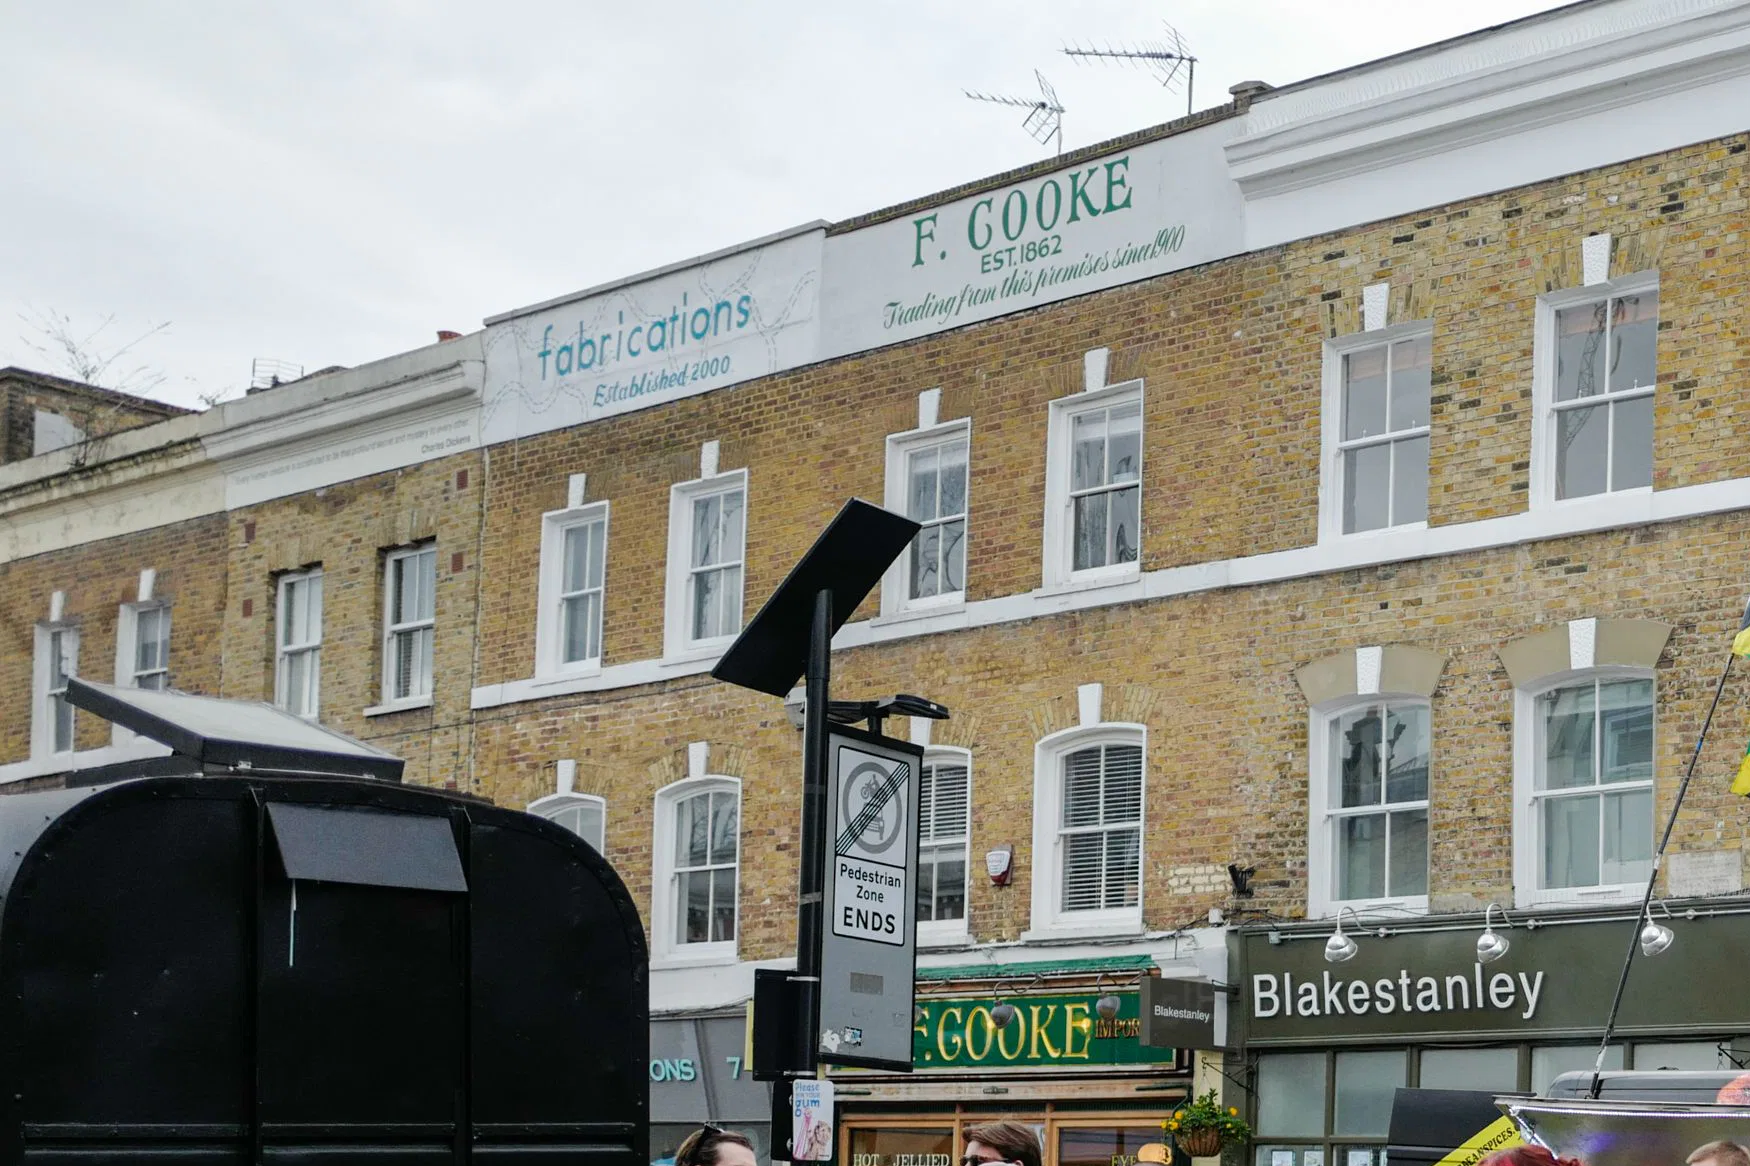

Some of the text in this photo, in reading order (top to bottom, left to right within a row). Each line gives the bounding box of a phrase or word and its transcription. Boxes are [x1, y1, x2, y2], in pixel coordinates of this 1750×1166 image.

[912, 156, 1132, 268] F. COOKE
[883, 291, 959, 330] Trading
[1000, 269, 1033, 299] this
[1031, 252, 1110, 297] premises
[538, 291, 751, 381] fabrications
[592, 355, 730, 409] Established 2000
[840, 863, 901, 888] Pedestrian
[856, 885, 884, 903] Zone
[843, 906, 896, 934] ENDS
[1253, 962, 1544, 1019] Blakestanley
[1154, 1005, 1210, 1023] Blakestanley
[937, 1003, 1091, 1061] COOKE
[649, 1058, 696, 1081] ONS
[795, 1082, 820, 1093] Please
[794, 1099, 820, 1117] gum
